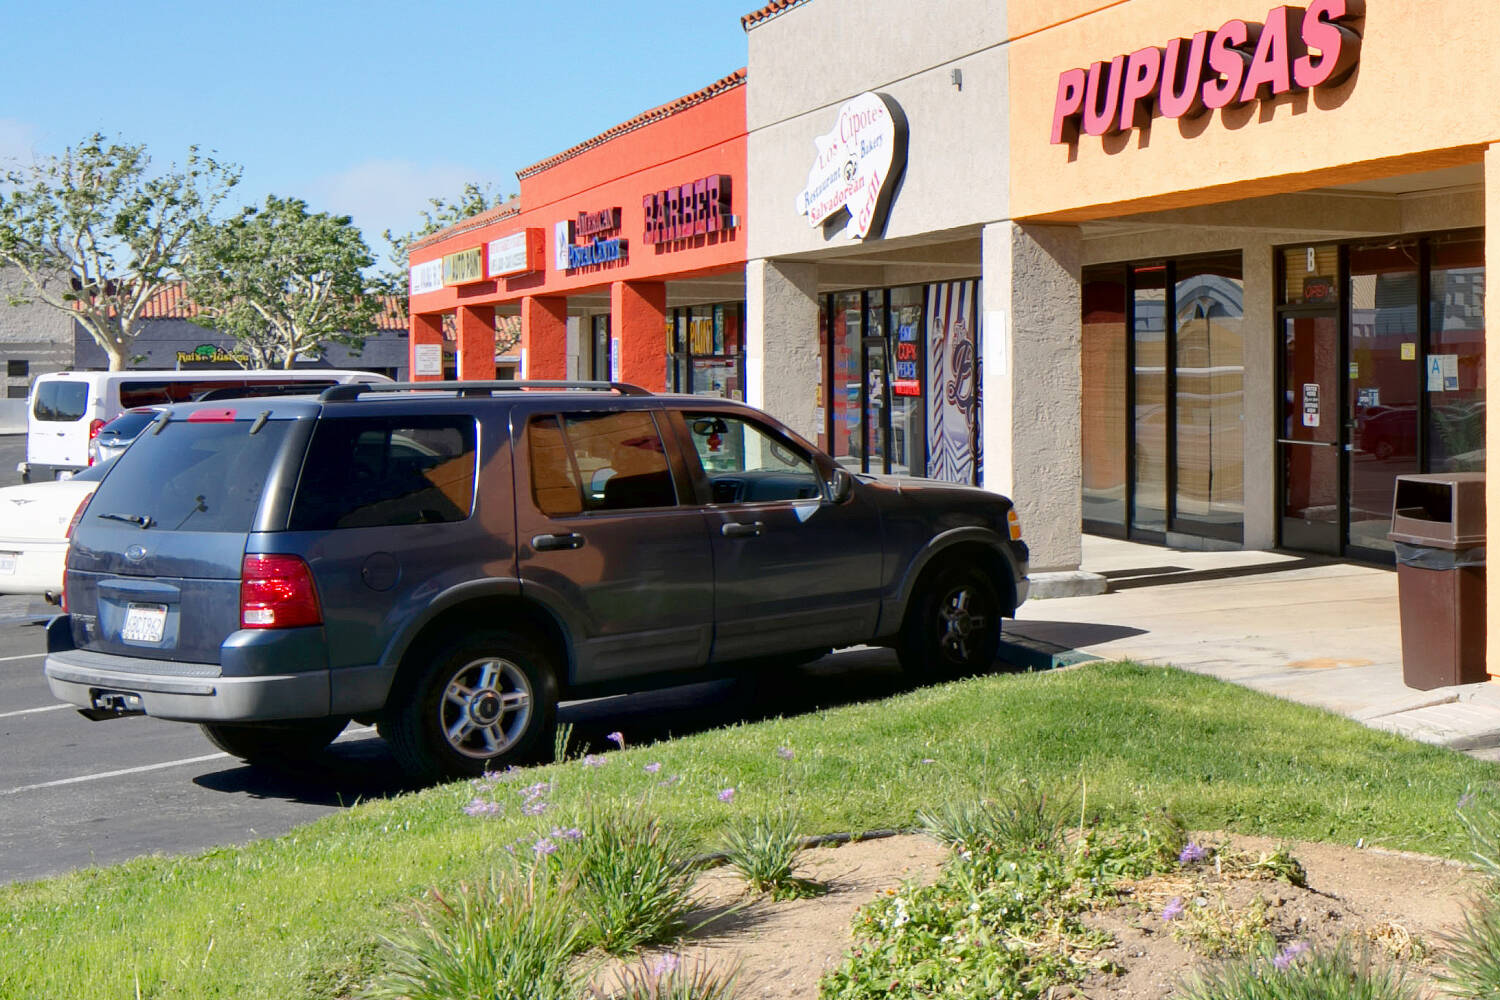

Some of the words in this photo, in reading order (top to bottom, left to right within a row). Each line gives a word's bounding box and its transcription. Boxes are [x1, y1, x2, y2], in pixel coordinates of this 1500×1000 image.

[840, 104, 884, 147] Cipotes
[643, 174, 722, 245] BARBER
[810, 176, 865, 224] Salvadorean
[1307, 247, 1315, 272] B
[1431, 358, 1441, 374] A
